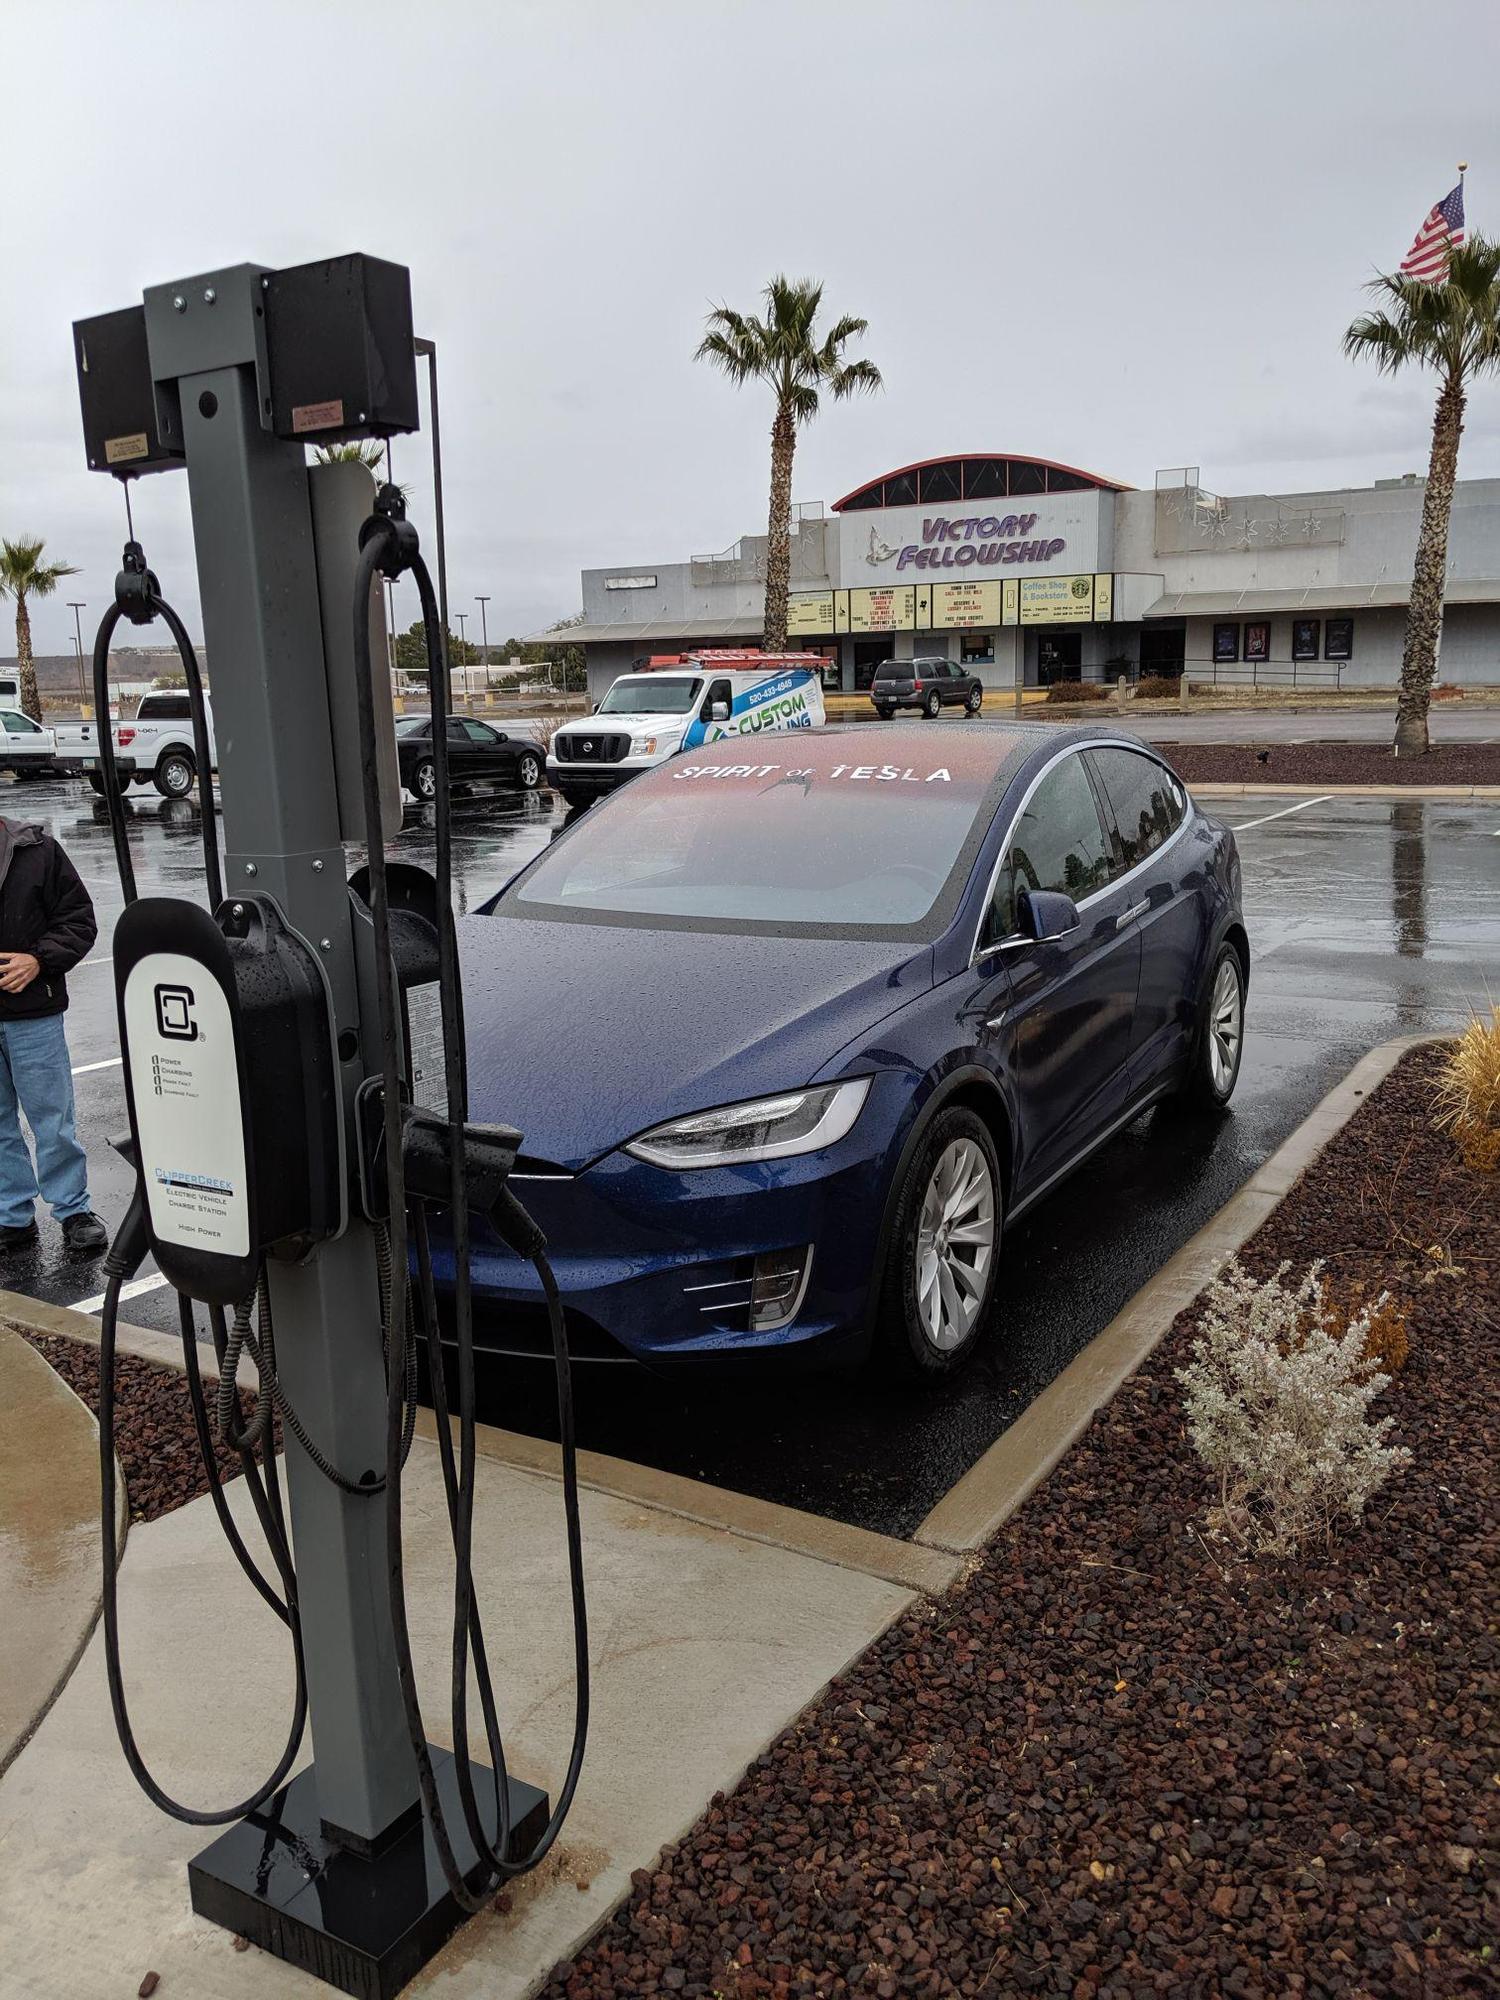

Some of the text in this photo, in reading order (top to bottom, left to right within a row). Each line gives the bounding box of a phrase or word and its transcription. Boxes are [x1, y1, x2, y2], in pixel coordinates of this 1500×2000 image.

[922, 513, 1037, 543] VICTORY
[896, 538, 1065, 570] FELLOWSHIP
[1022, 582, 1047, 592] Coffee
[1048, 580, 1067, 591] Shop
[1022, 592, 1069, 601] & Bookstore
[749, 678, 793, 704] 520-433-4949
[738, 693, 806, 734] CUSTOM
[673, 765, 781, 779] SPIRIT
[829, 764, 952, 782] TESLA
